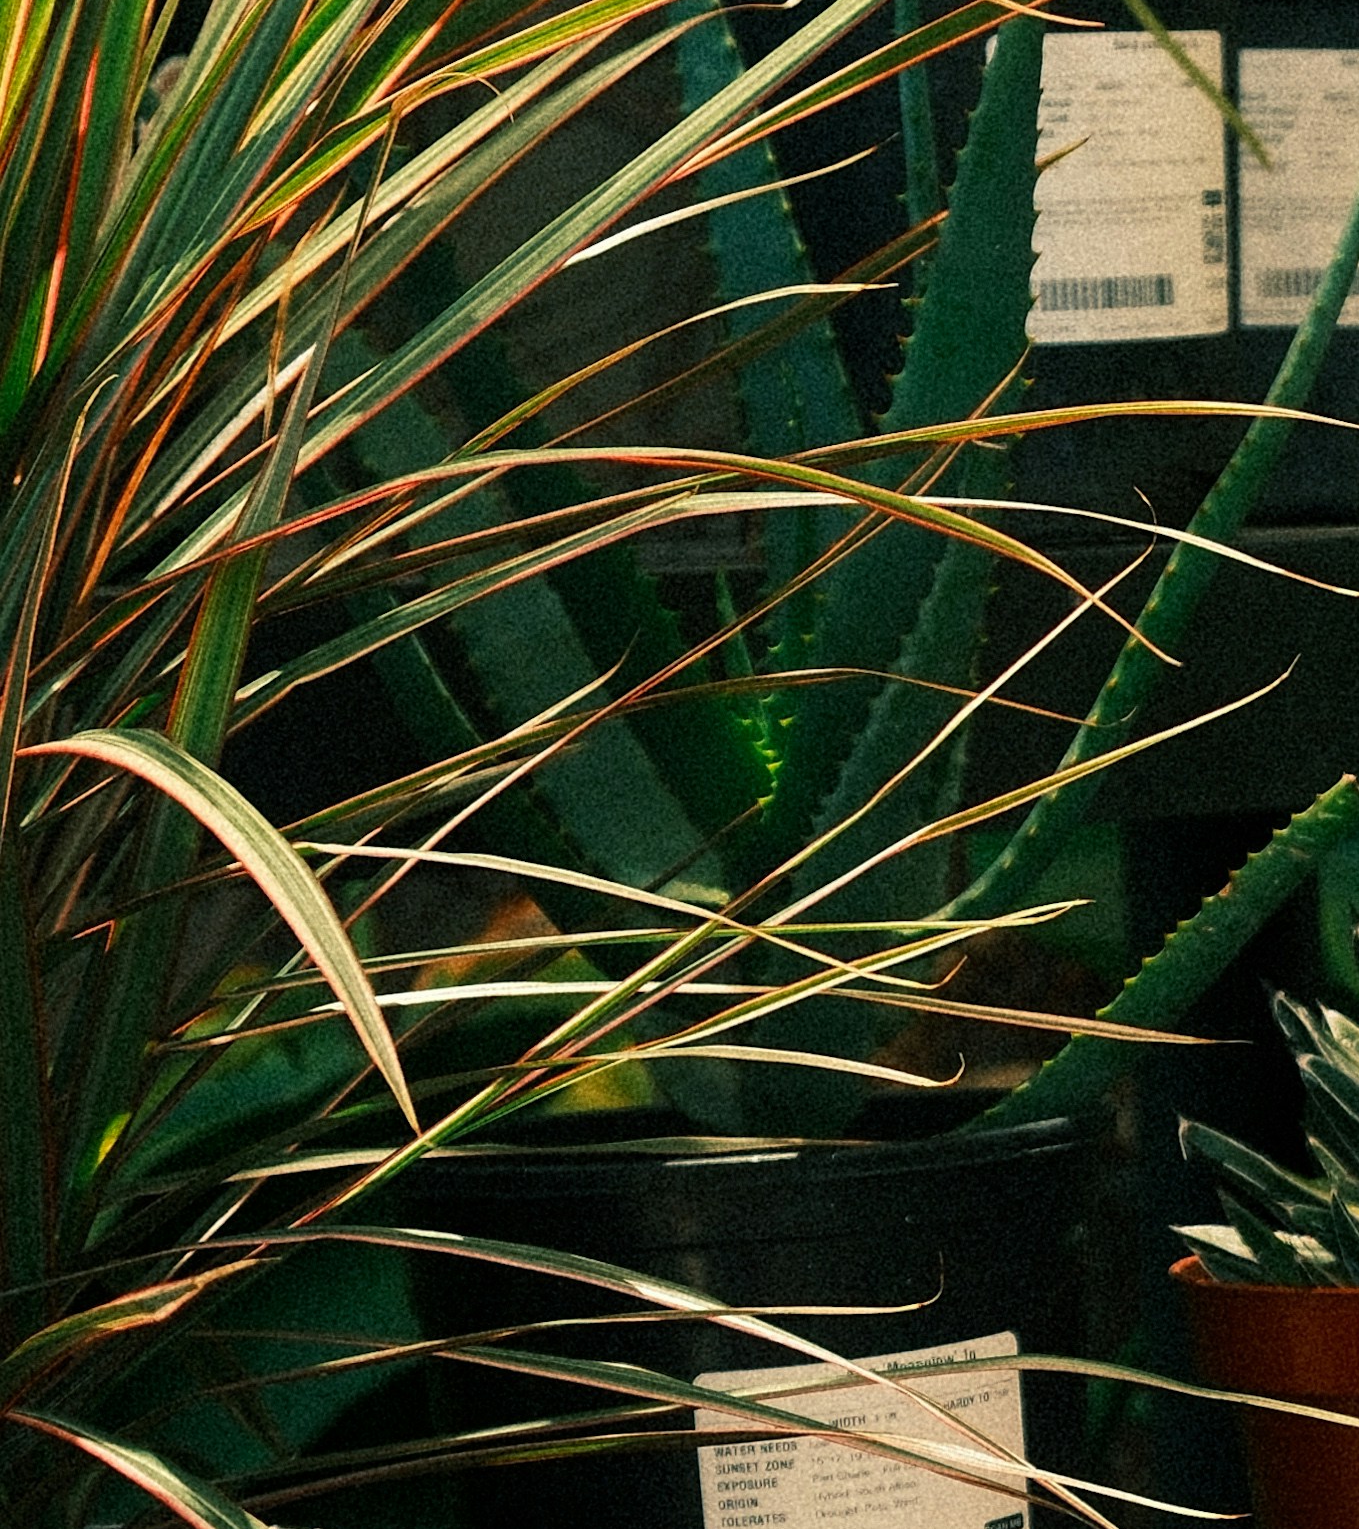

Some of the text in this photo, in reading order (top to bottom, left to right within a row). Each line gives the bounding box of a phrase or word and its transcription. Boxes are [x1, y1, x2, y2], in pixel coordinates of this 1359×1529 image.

[714, 1444, 755, 1457] WATER
[760, 1440, 798, 1454] NEEDS
[715, 1462, 759, 1475] SUNSET
[765, 1458, 795, 1471] ZONE
[717, 1478, 779, 1492] EXPOSURE
[718, 1498, 759, 1511] ORIGIN
[721, 1513, 787, 1528] TOLERATES
